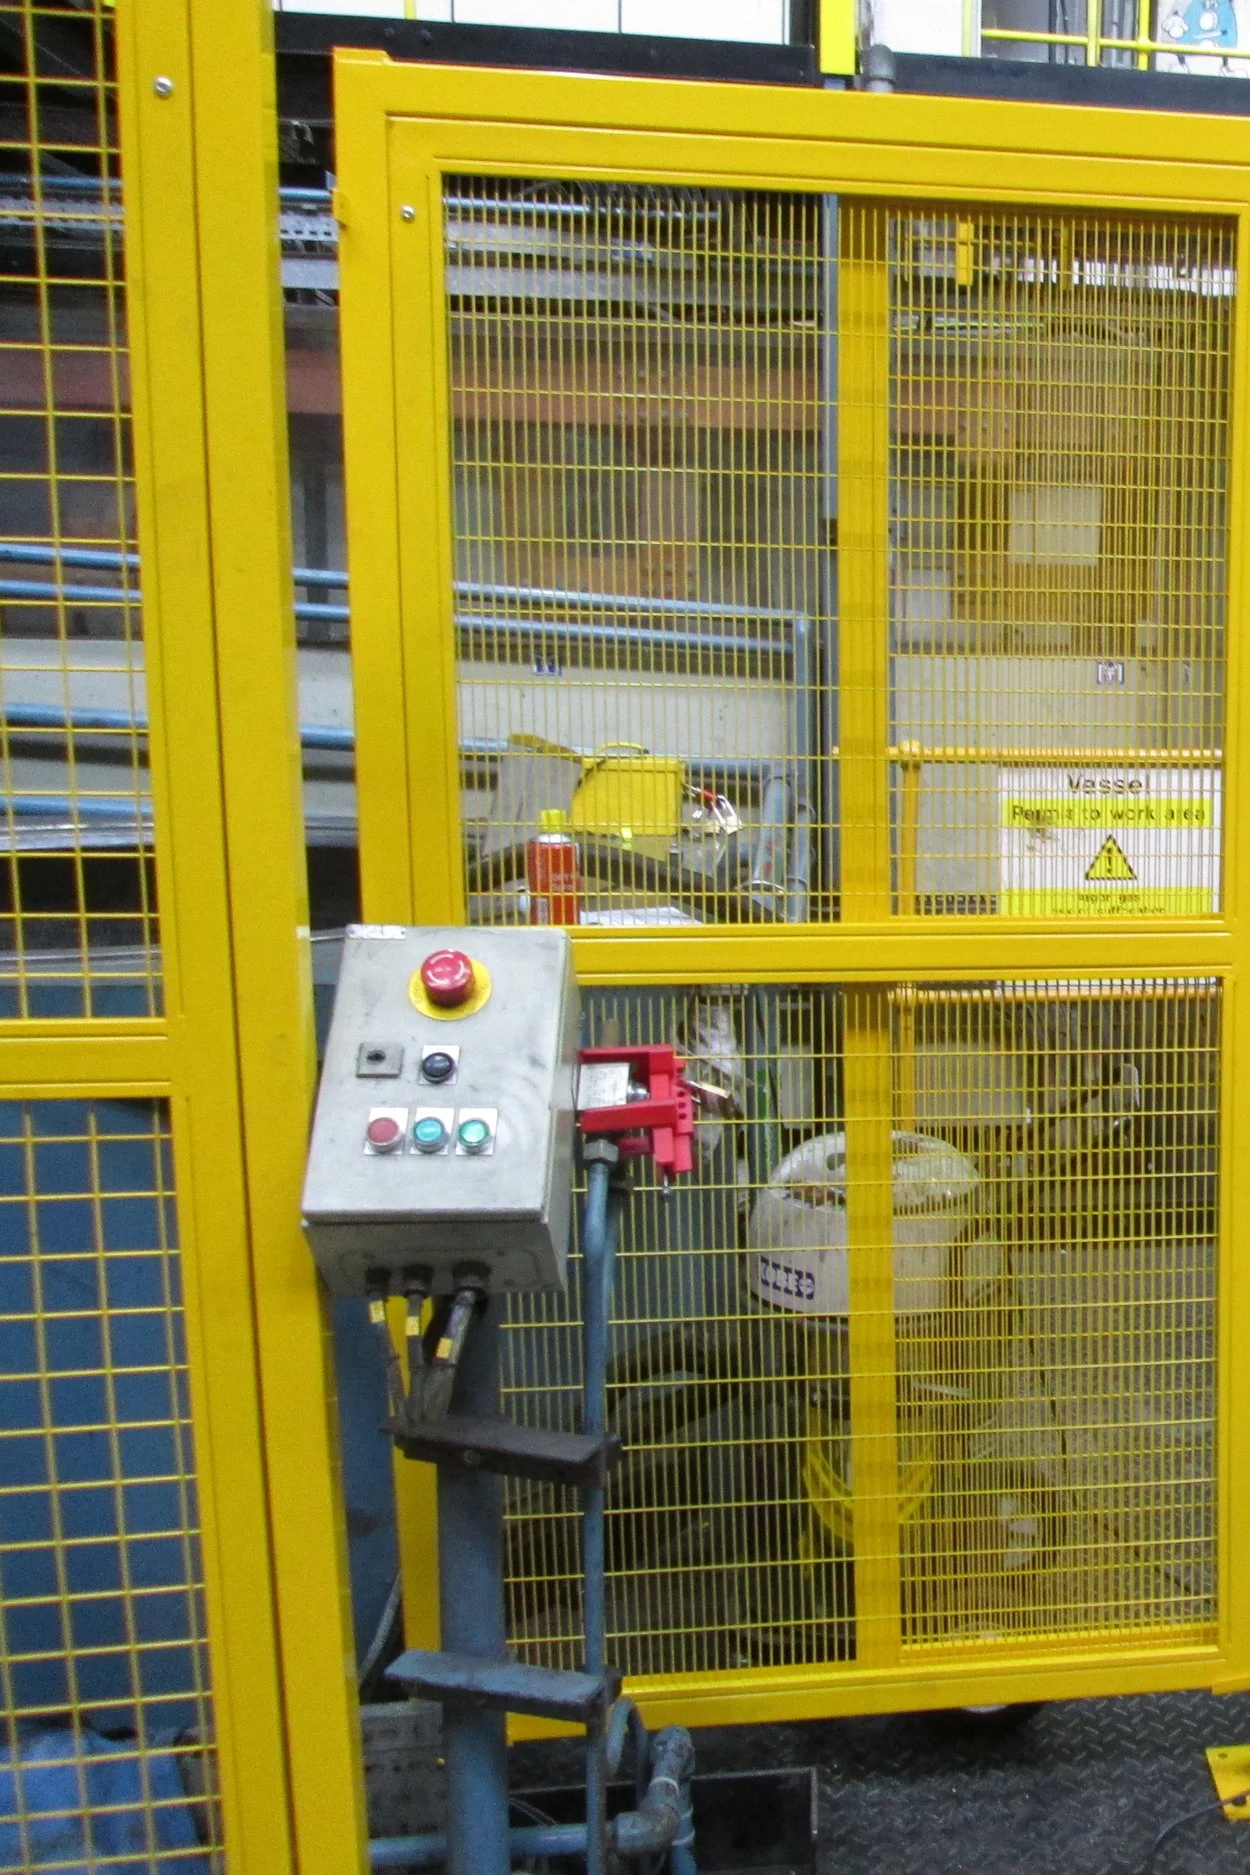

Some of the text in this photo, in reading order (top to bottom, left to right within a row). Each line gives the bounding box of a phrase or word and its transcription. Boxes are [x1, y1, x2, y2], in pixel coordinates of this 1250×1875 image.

[1012, 805, 1205, 821] Permit to work area
